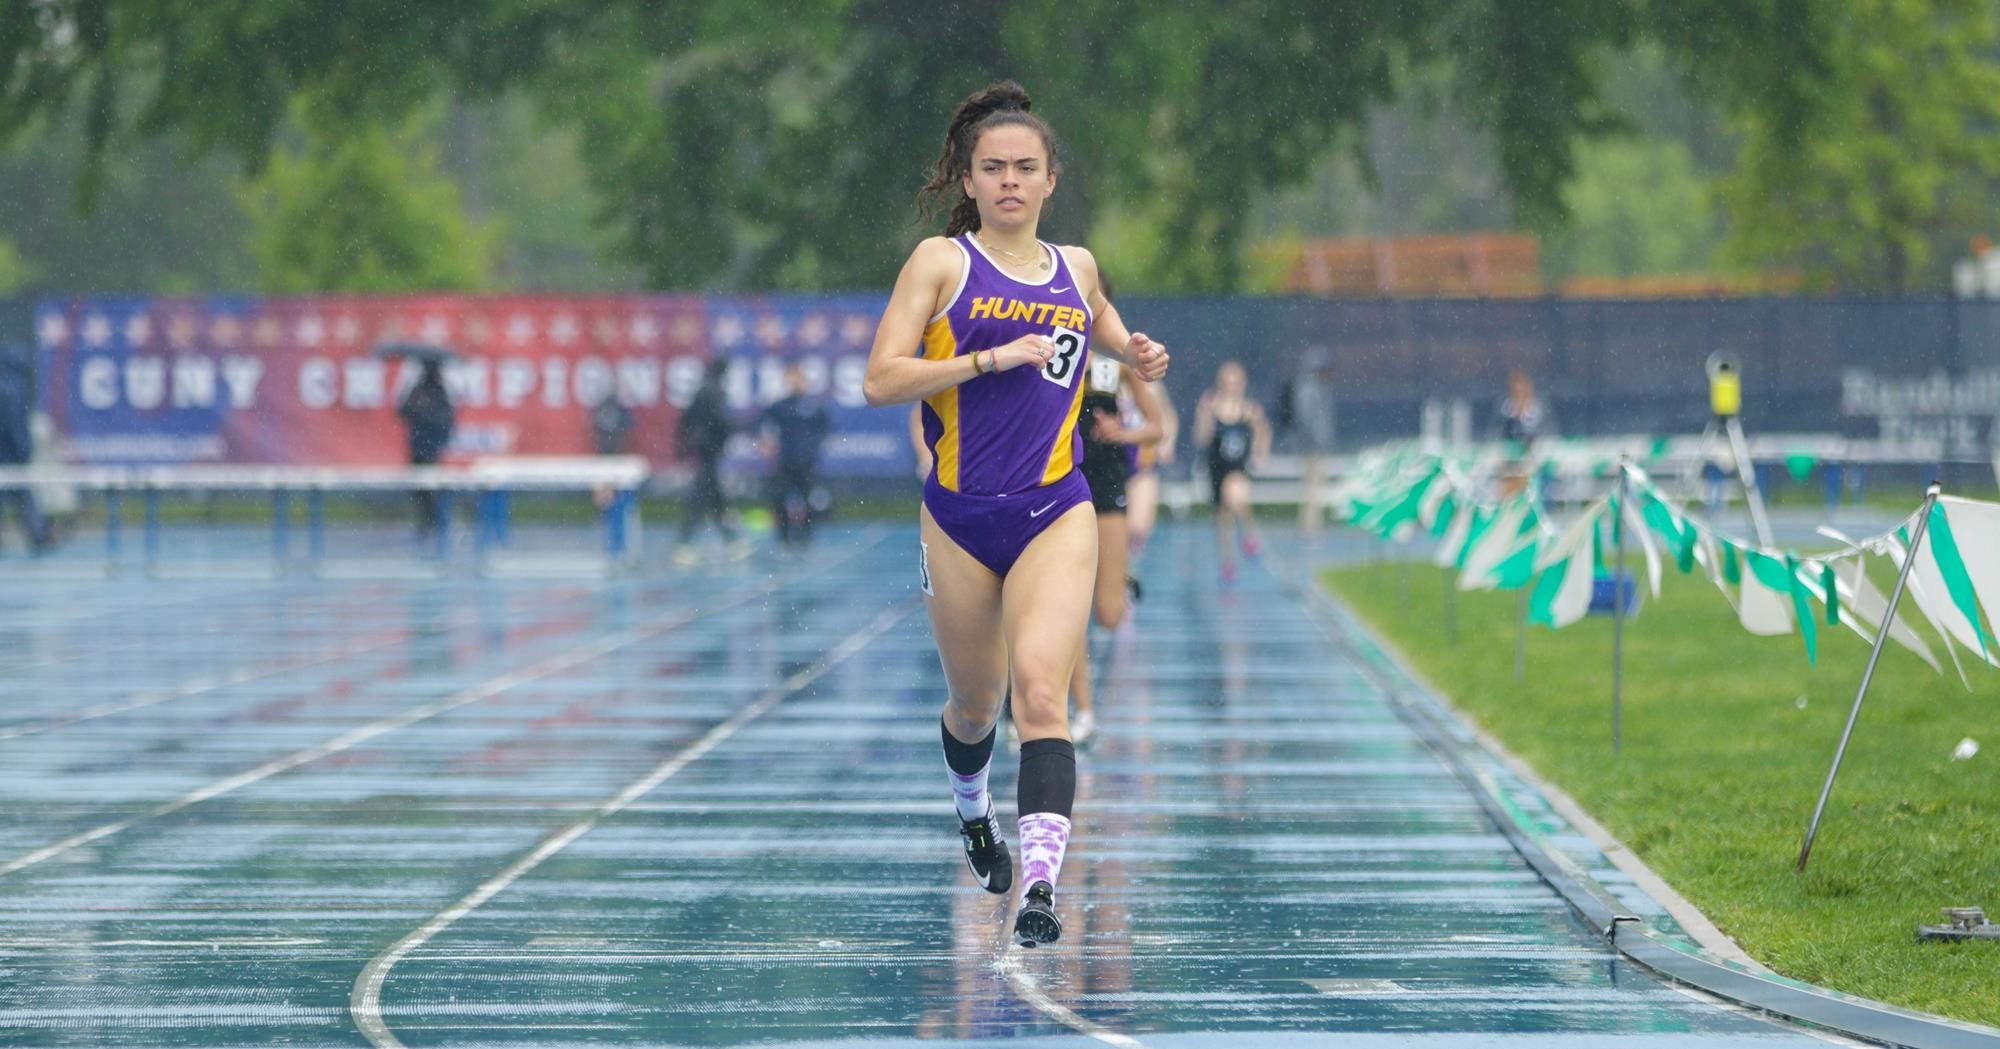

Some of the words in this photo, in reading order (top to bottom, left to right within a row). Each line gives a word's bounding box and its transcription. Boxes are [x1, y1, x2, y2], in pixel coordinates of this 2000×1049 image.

[968, 296, 1087, 332] HUNTER
[1046, 333, 1079, 380] 3
[79, 355, 264, 410] CUNY
